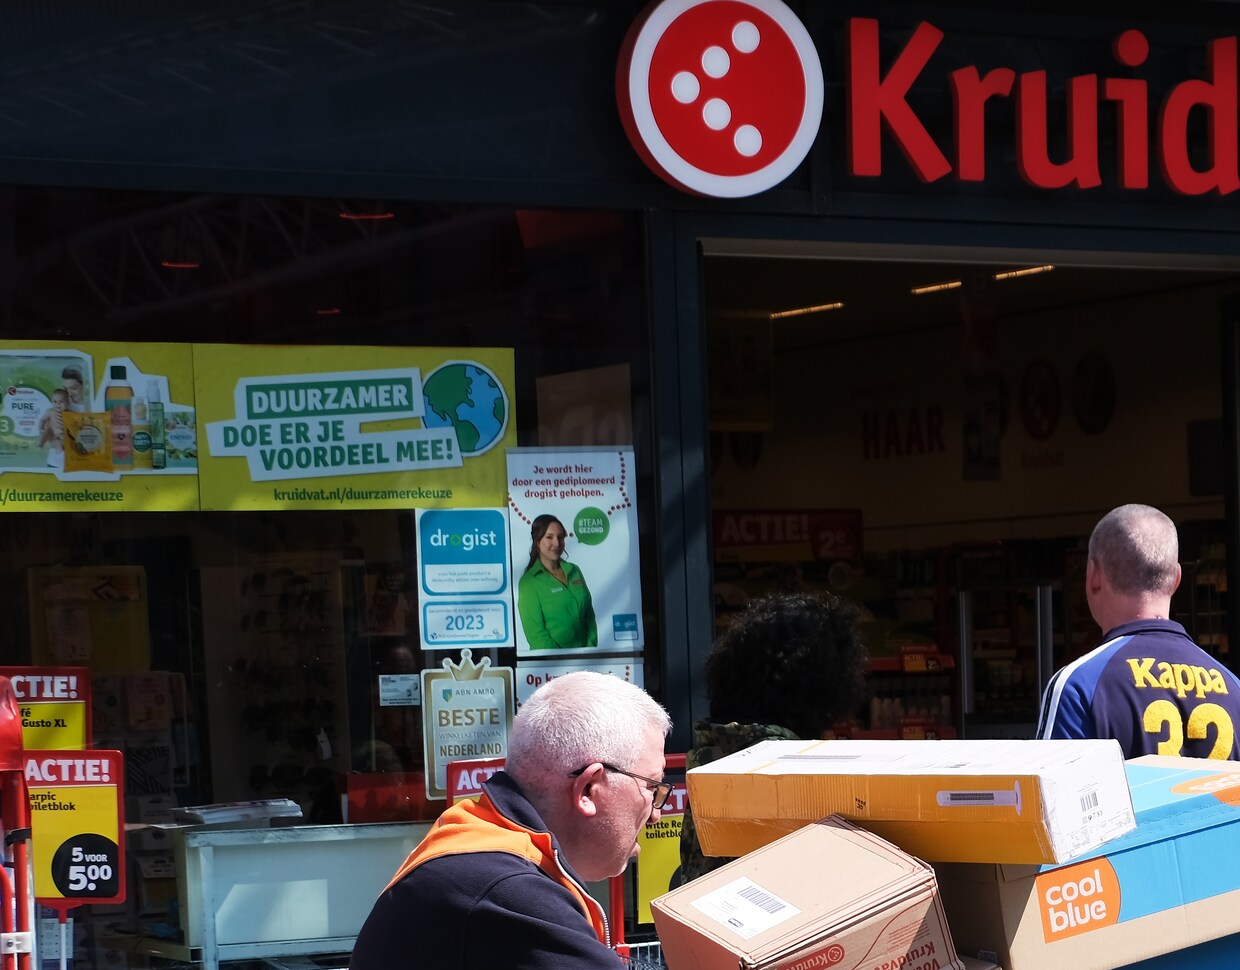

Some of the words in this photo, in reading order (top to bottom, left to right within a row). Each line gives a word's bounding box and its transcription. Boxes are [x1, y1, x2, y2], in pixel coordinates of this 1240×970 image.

[252, 384, 409, 414] DUURZAMER
[223, 423, 273, 448] DOE
[280, 421, 311, 445] ER
[317, 420, 345, 443] JE
[861, 406, 945, 460] HAAR
[260, 442, 389, 471] VOORDEEL
[396, 438, 454, 463] MEE!
[533, 465, 544, 474] Je
[546, 464, 572, 473] wordt
[574, 463, 593, 473] hier
[512, 477, 533, 486] door
[535, 478, 552, 486] een
[554, 476, 616, 488] gediplomeerd
[273, 487, 453, 504] kruidvat.nl/duurzamerekeuze
[524, 488, 557, 500] drogist
[559, 488, 605, 500] geholpen.
[578, 518, 603, 527] #TEAM
[720, 513, 811, 543] ACTIE!
[430, 528, 497, 551] drogist
[445, 615, 485, 631] 2023
[10, 675, 78, 699] CTIE!
[526, 673, 543, 687] Op
[1126, 657, 1229, 699] Kappa
[473, 688, 496, 696] AMRO
[22, 718, 52, 729] Gusto
[54, 718, 68, 728] XL
[438, 708, 500, 727] BESTE
[439, 731, 485, 740] WINKELKETEN
[486, 730, 501, 738] VAN
[1143, 699, 1235, 760] 32
[440, 742, 502, 757] NEDERLAND
[26, 759, 111, 783] ACTIE!
[30, 791, 57, 803] arpic
[645, 820, 669, 830] Witte
[72, 847, 83, 863] 5
[85, 854, 108, 862] VOOR
[68, 865, 113, 891] 5.00
[1045, 869, 1103, 906] cool
[1048, 900, 1107, 933] blue
